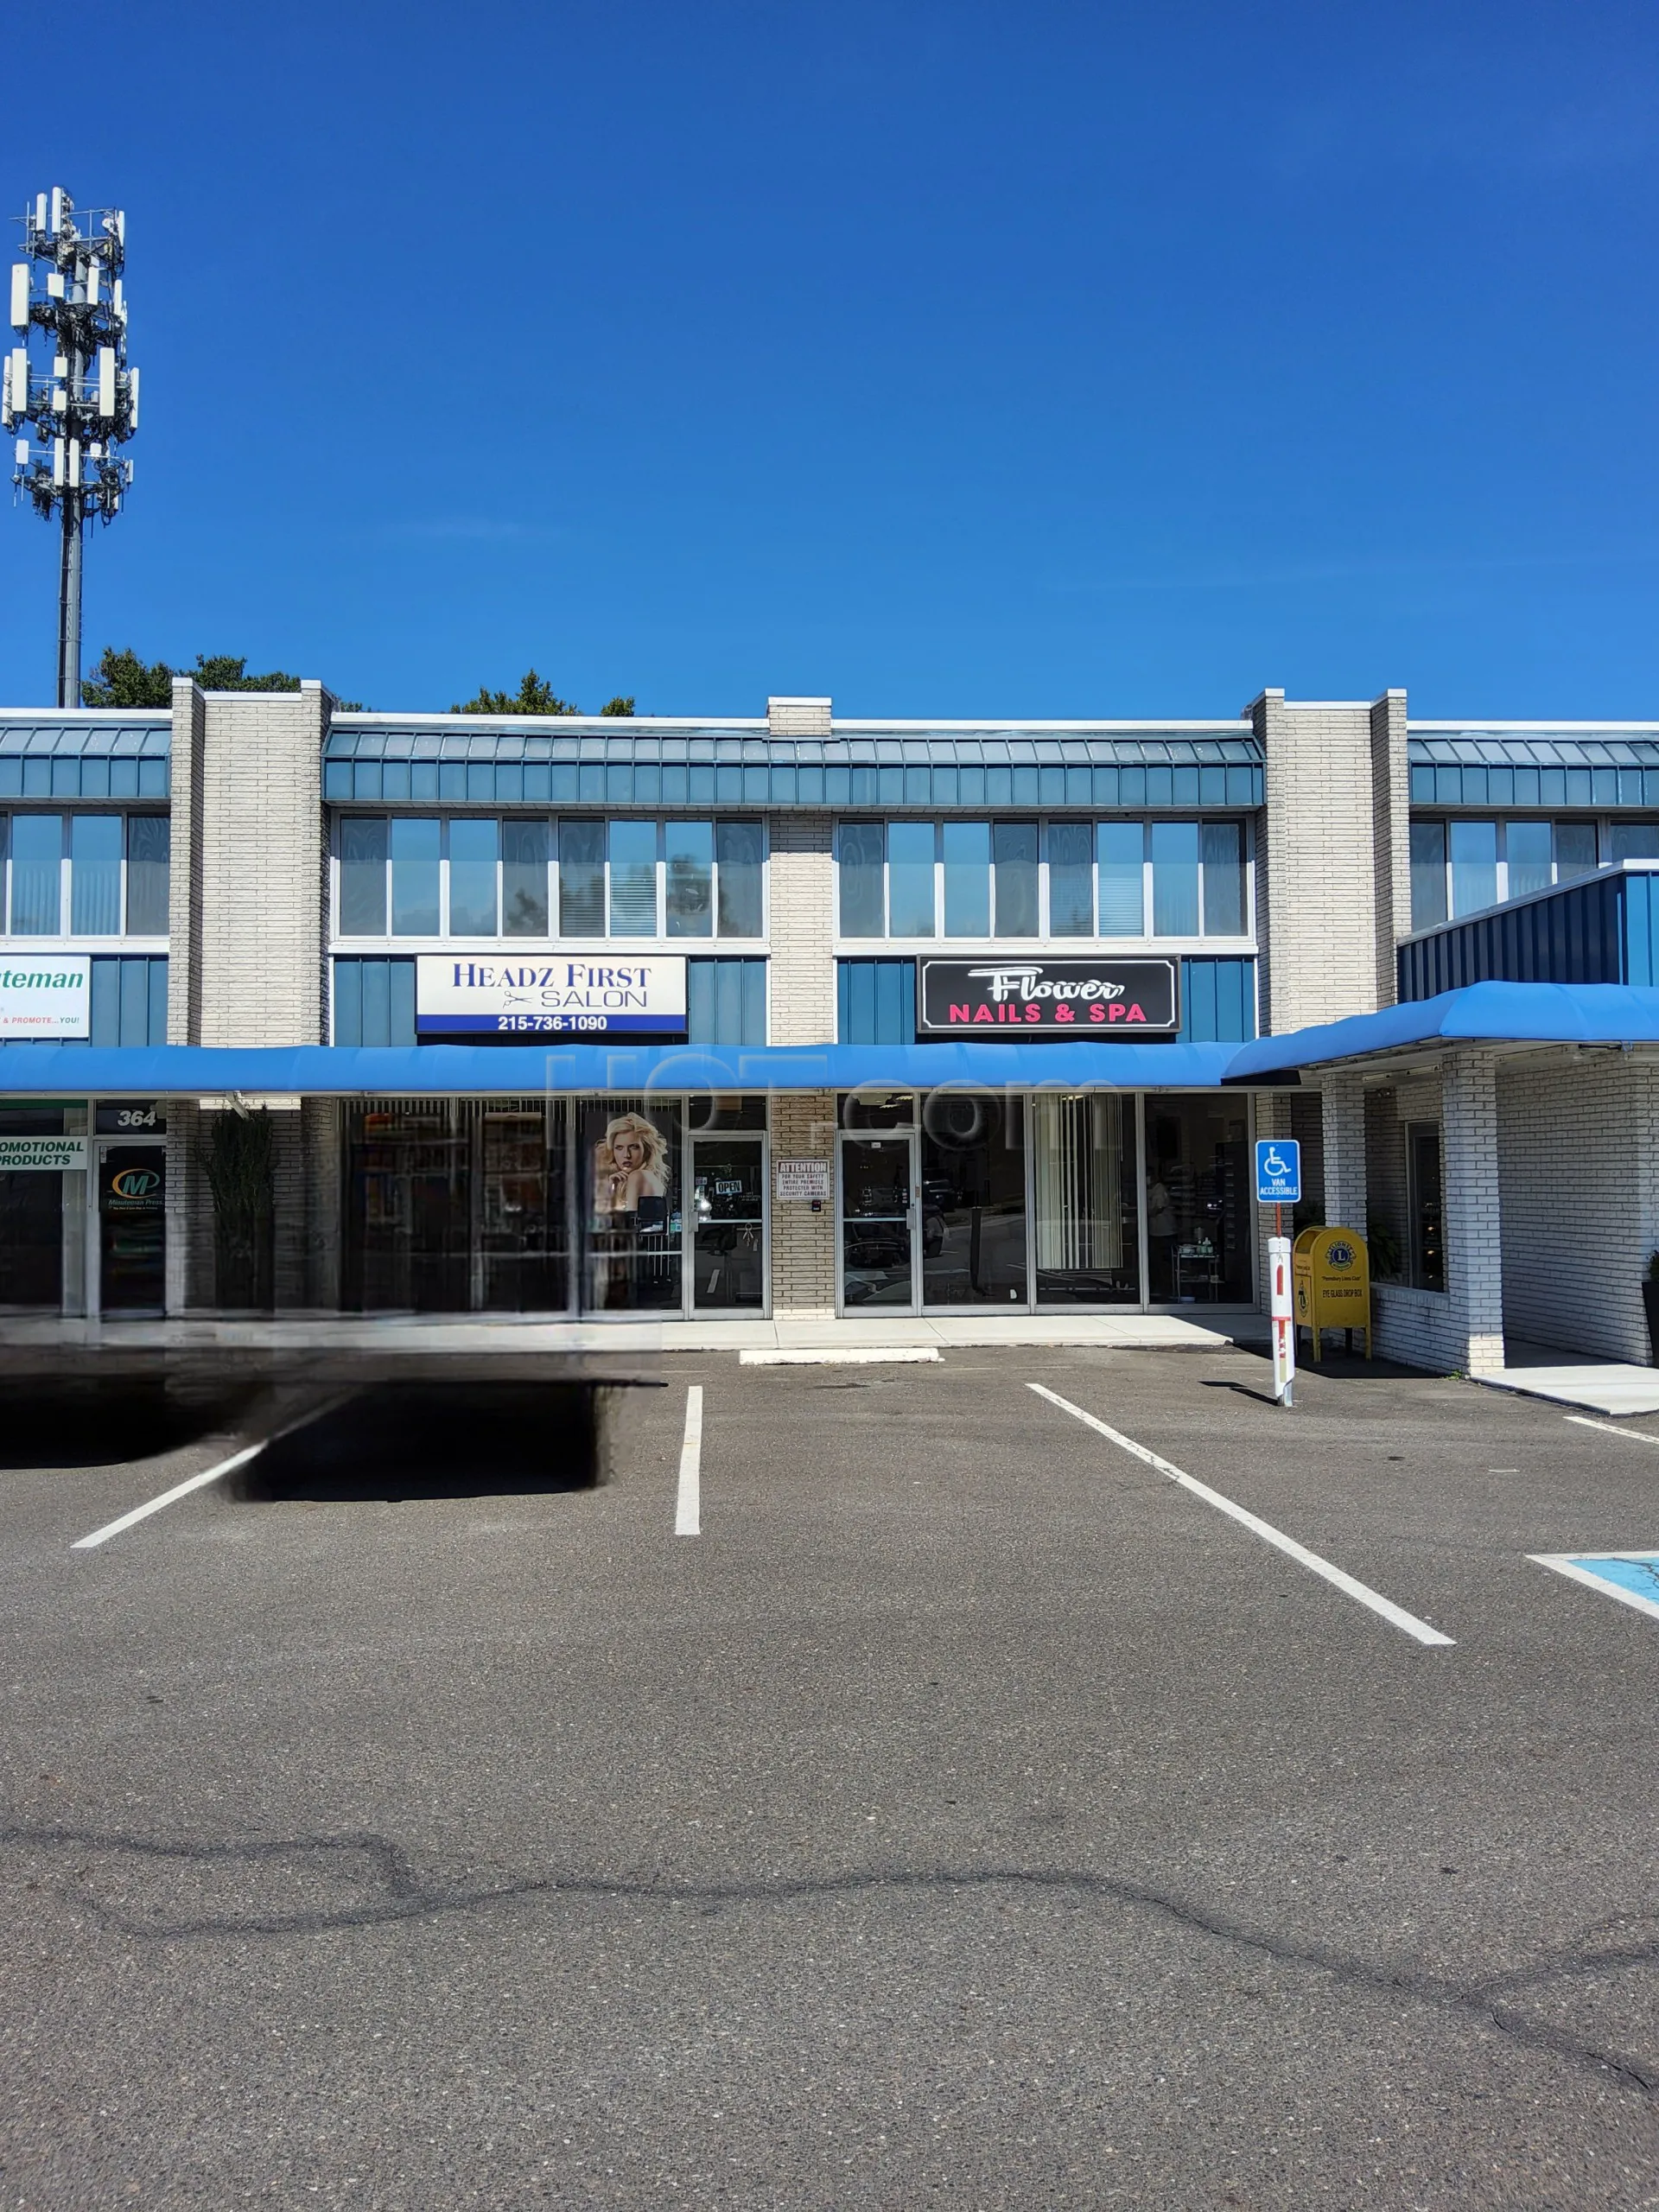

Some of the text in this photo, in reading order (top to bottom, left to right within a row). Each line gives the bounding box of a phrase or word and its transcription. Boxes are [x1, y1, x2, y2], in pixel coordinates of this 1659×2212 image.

[0, 969, 84, 988] teman
[452, 963, 652, 988] HEADZ FIRST
[968, 966, 1125, 1002] Flower
[541, 990, 647, 1008] SALON
[950, 1003, 1147, 1022] NAILS & SPA
[498, 1015, 607, 1031] 215-736-1090
[117, 1110, 156, 1127] 364
[0, 1154, 71, 1166] RODUCTS
[779, 1162, 827, 1173] ATTENTION
[718, 1182, 741, 1193] OPEN
[1260, 1186, 1297, 1195] ACCESSIBLE
